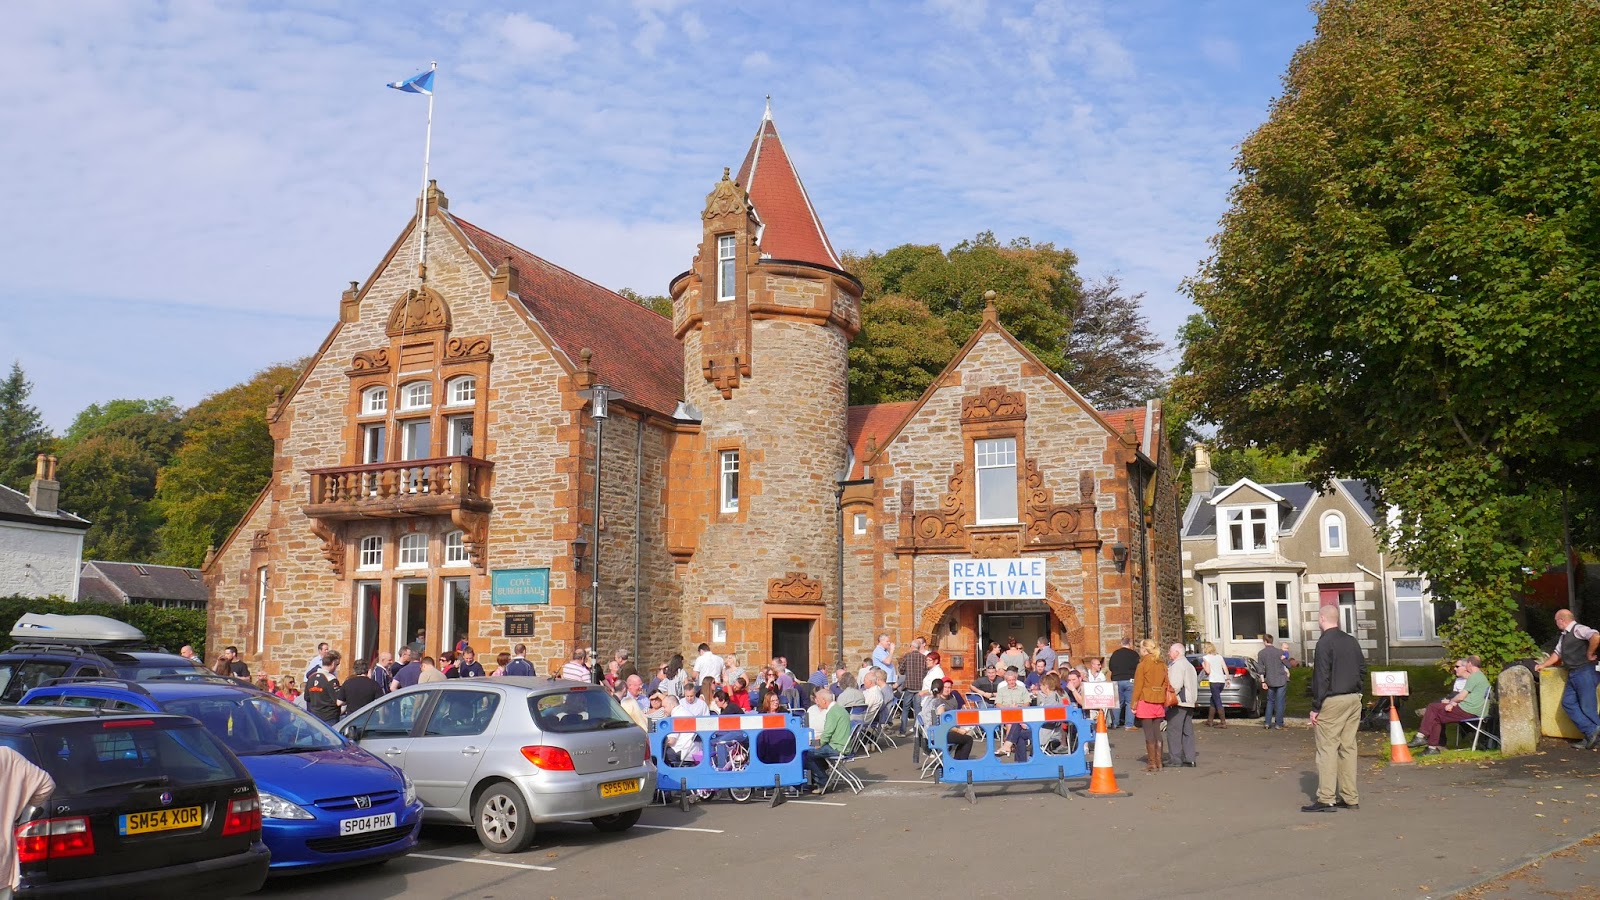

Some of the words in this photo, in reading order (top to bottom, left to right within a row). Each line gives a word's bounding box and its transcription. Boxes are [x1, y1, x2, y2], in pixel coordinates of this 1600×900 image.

[953, 562, 997, 577] REAL
[1007, 561, 1041, 576] ALE
[510, 578, 531, 586] COVE
[954, 580, 1041, 596] FESTIVAL
[497, 587, 522, 595] BURGH
[524, 587, 542, 595] HALL
[604, 782, 622, 793] SP55
[130, 811, 168, 830] SM54
[172, 807, 198, 825] XOR
[345, 818, 371, 832] SP04
[373, 815, 391, 828] PHX
